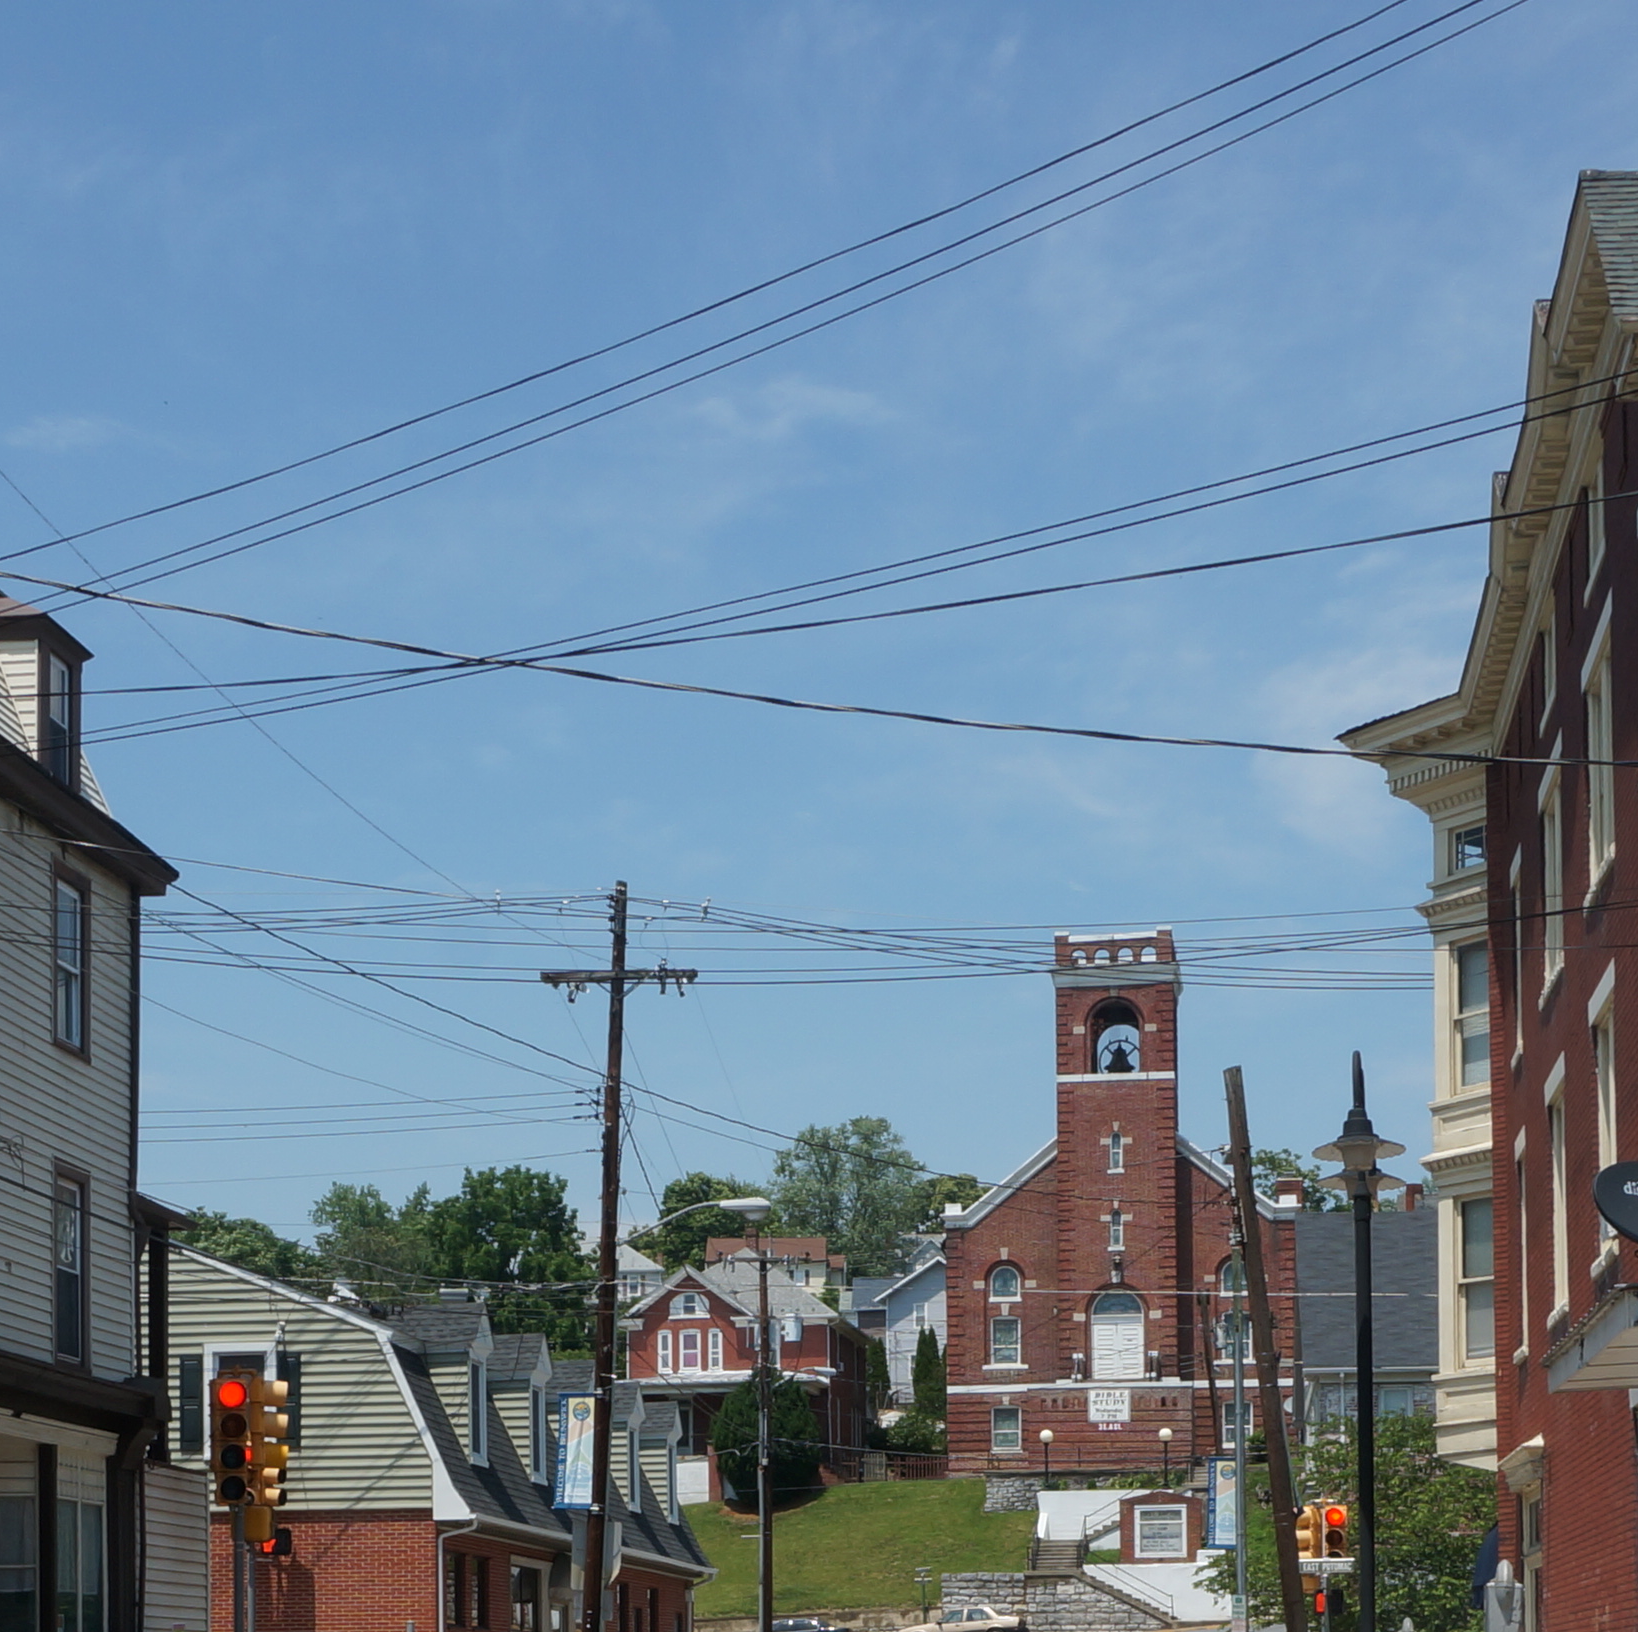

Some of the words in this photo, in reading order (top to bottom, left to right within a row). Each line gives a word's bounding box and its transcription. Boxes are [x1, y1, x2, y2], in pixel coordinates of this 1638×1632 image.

[1095, 1391, 1126, 1399] BIBLE
[1303, 1562, 1319, 1571] EAST
[1322, 1562, 1353, 1571] POTOMAC
